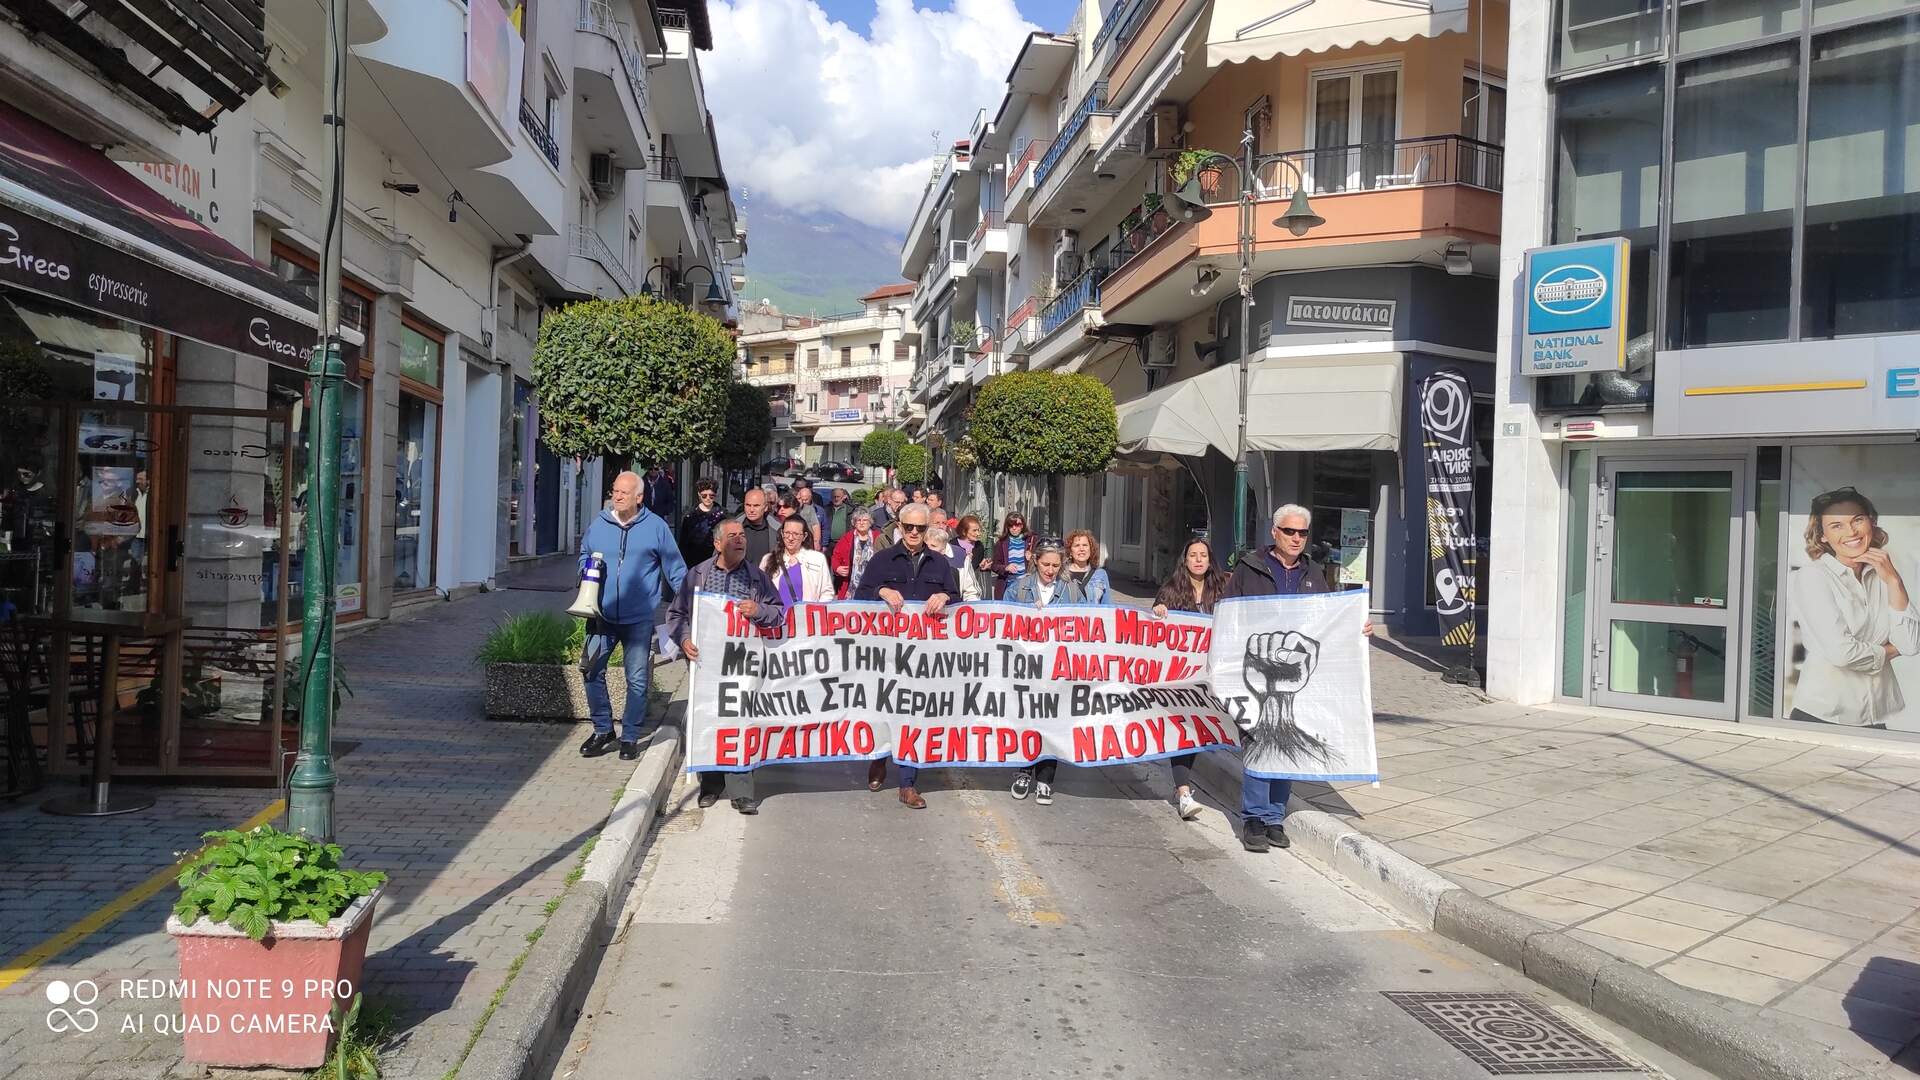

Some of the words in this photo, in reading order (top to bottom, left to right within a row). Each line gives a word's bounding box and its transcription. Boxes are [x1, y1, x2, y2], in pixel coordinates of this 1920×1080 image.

[88, 272, 148, 306] espresserie
[249, 317, 297, 357] Greco
[1534, 334, 1603, 349] NATIONAL
[1534, 348, 1573, 361] BANK
[1555, 360, 1589, 369] GROUP
[805, 604, 949, 640] ΠΡΟΧΩΡΑΜΕ
[954, 605, 1107, 643] ΟΡΓΑΝΩΜΕΝΑ
[1115, 608, 1211, 654] ΜΠΡΟΣΤΑ
[833, 637, 886, 673] ΤΗΝ
[895, 643, 989, 679] ΚΑΛΥΨΗ
[996, 644, 1043, 680] ΤΩΝ
[1051, 645, 1162, 686] ΑΝΑΓΚΩΝ
[717, 681, 811, 718] ΕΝΑΝΤΙΑ
[820, 677, 867, 713] ΣΤΑ
[876, 678, 955, 718] ΚΕΡΔΗ
[962, 682, 1006, 718] ΚΑΙ
[1013, 684, 1058, 719] ΤΗΝ
[716, 719, 875, 767] ΕΡΓΑΤΙΚΟ
[898, 725, 1042, 763] ΚΕΝΤΡΟ
[1073, 714, 1236, 763] ΝΑΟΥΣΑΣ
